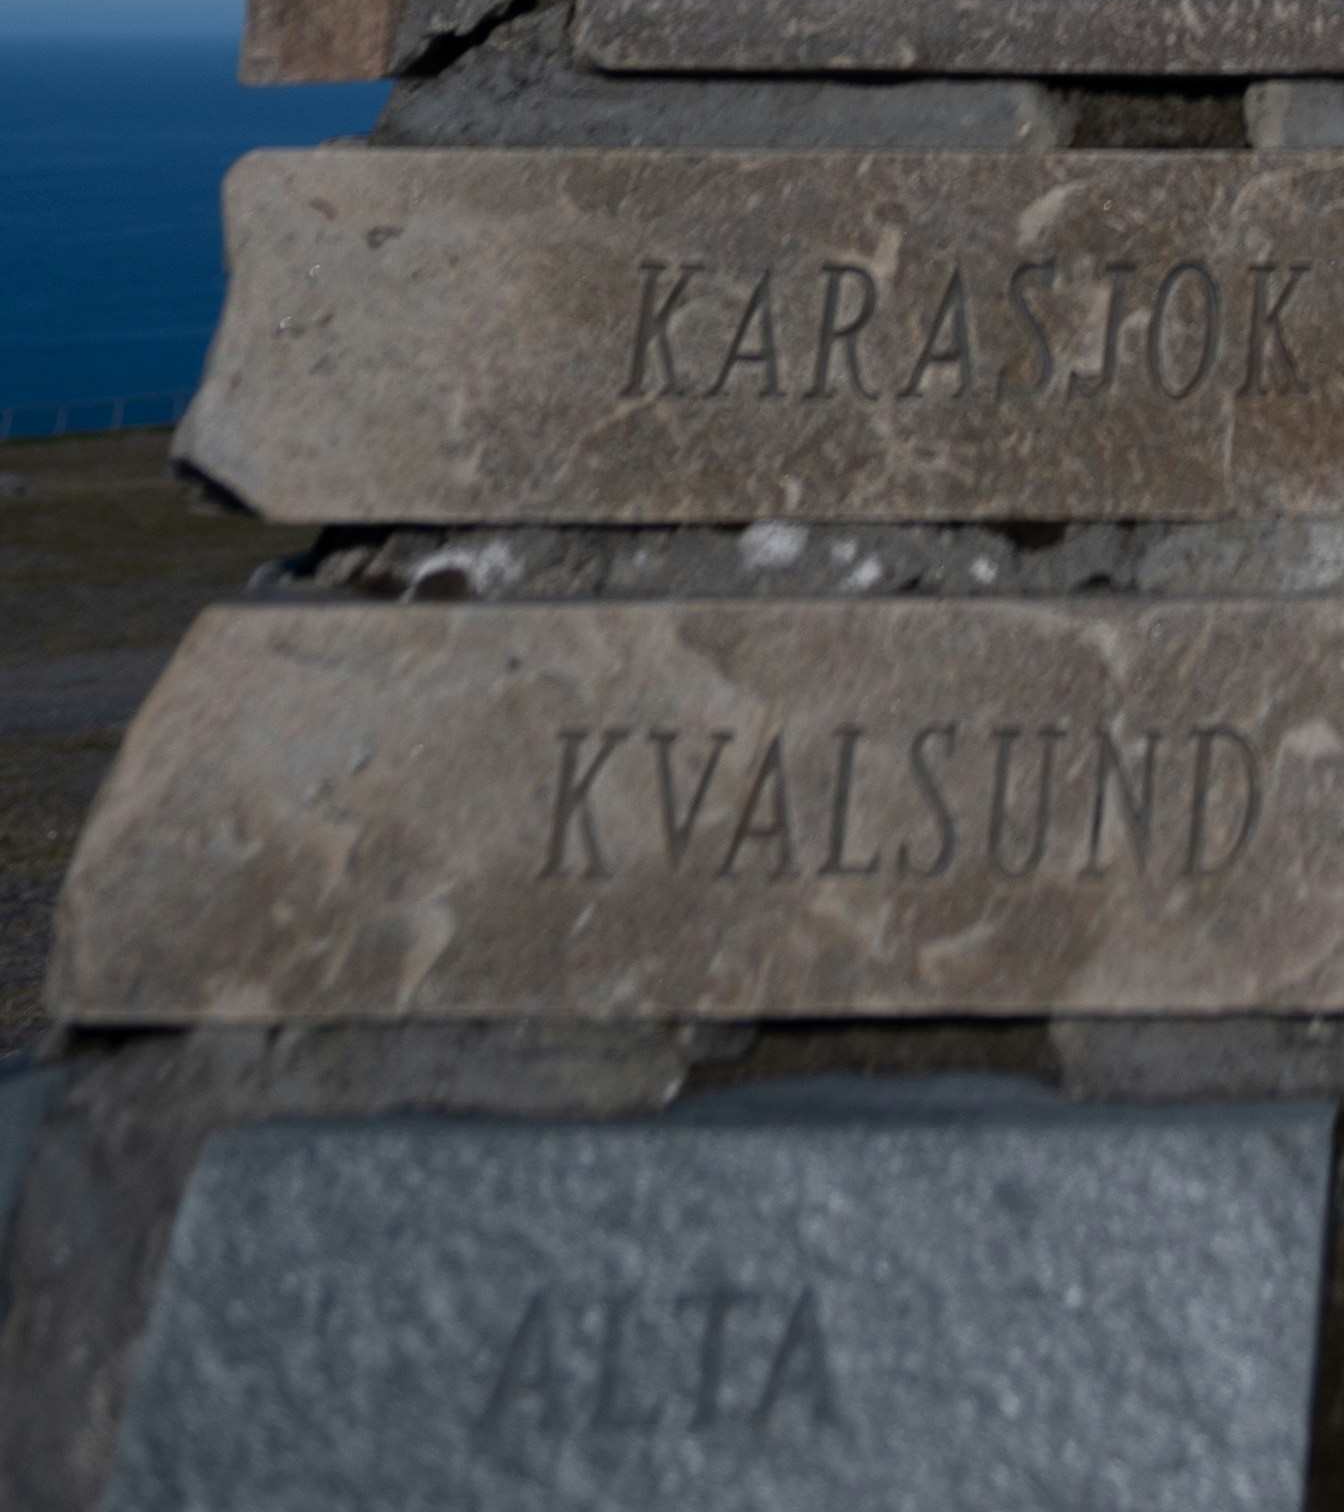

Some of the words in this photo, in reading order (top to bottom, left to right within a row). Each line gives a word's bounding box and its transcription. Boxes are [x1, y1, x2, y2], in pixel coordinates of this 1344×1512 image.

[618, 261, 1316, 402] KARASJOK
[540, 724, 1264, 880] KVALSUND
[482, 1284, 850, 1436] ALTA
